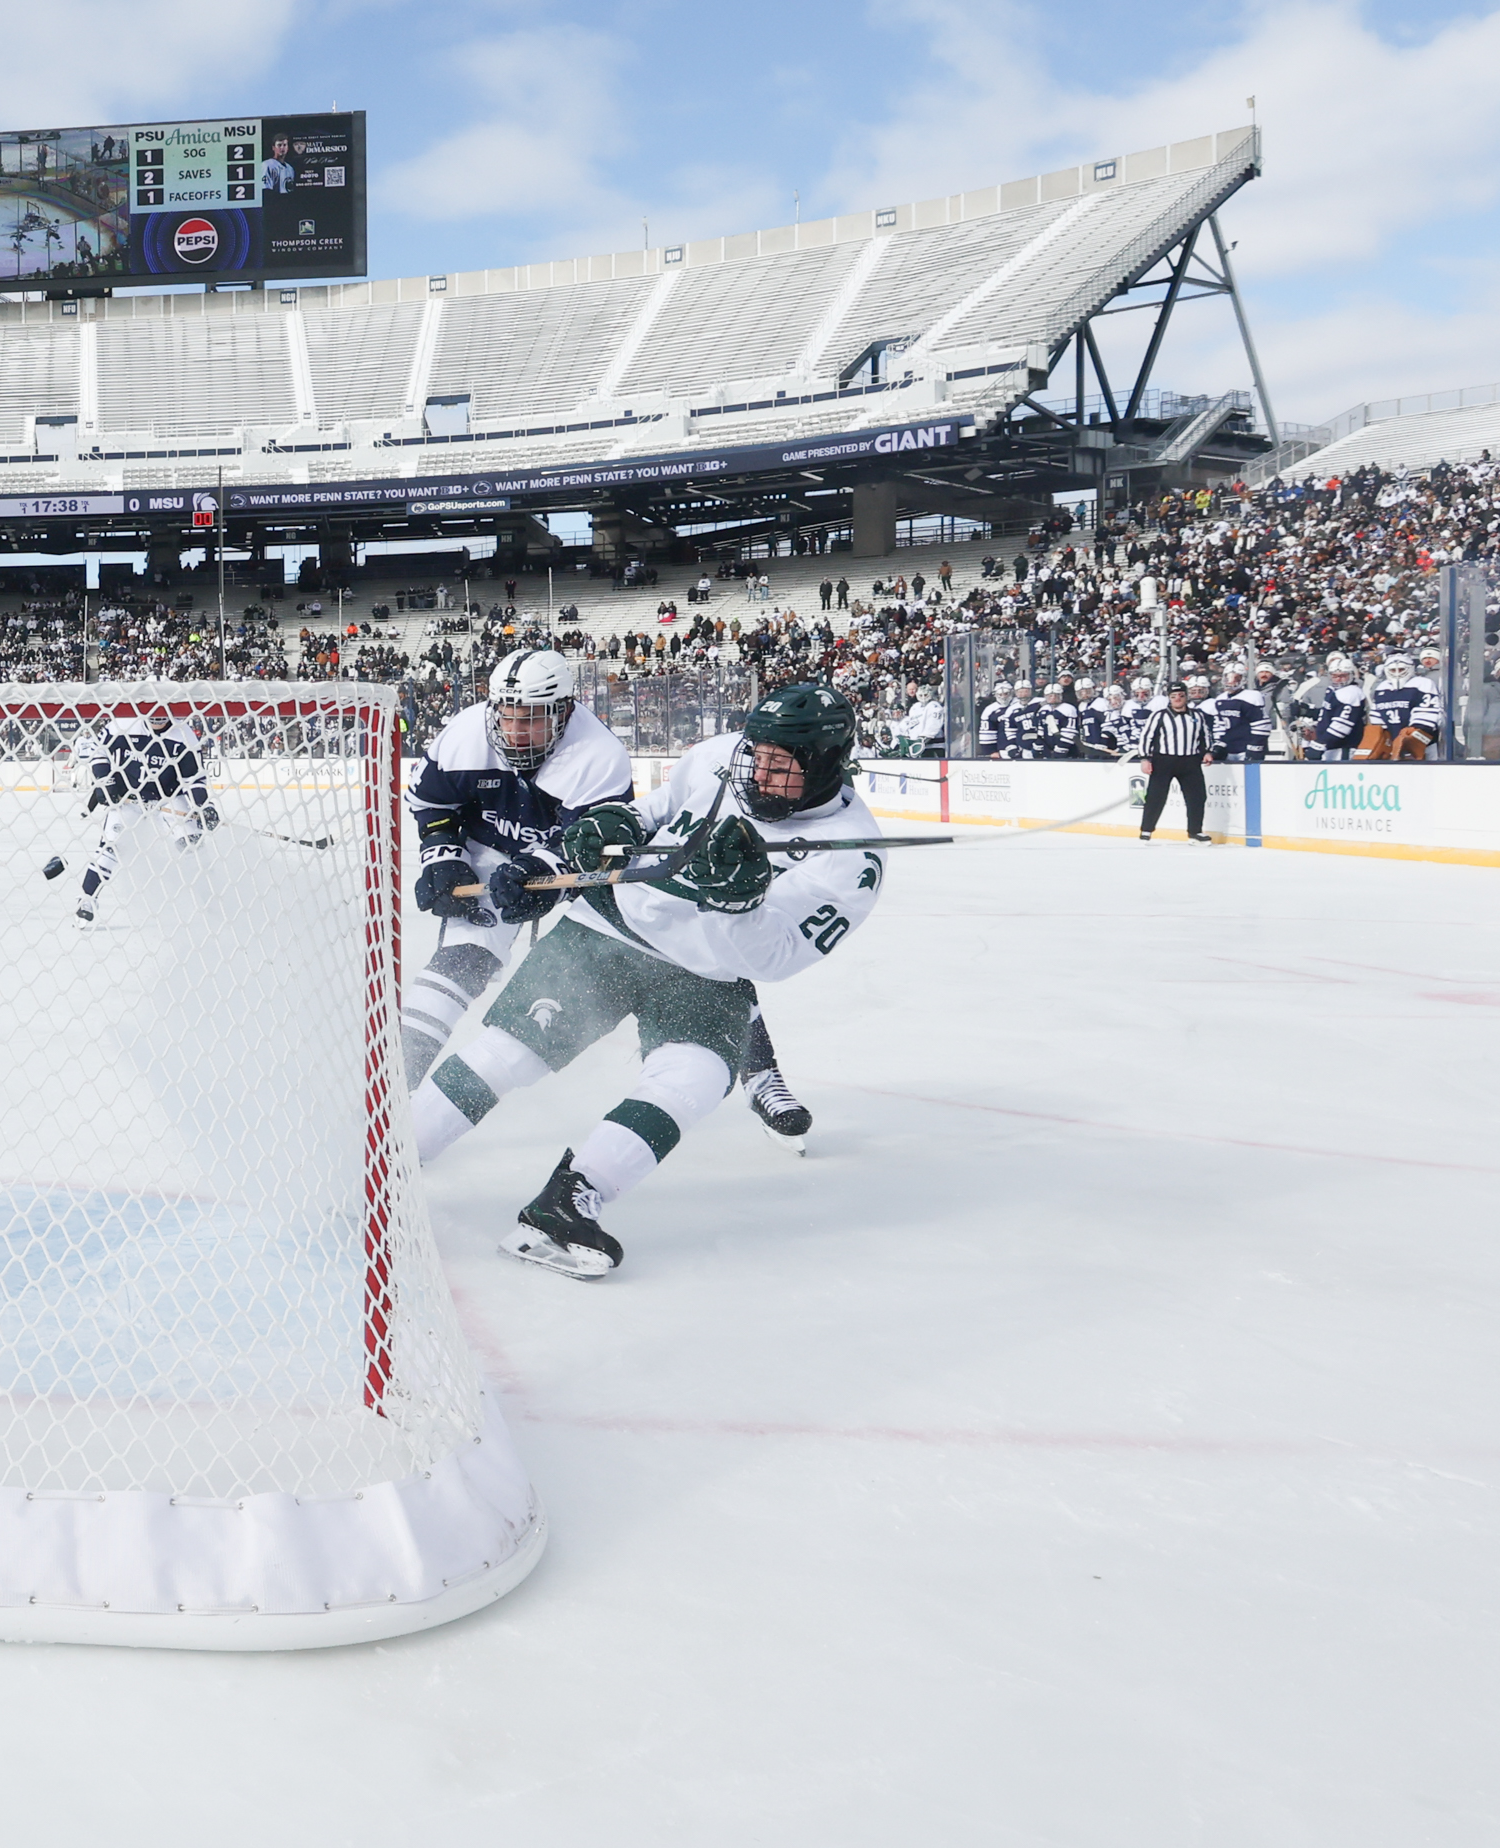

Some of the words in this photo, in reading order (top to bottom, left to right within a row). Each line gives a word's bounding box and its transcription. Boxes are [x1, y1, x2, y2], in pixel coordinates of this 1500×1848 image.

[135, 130, 165, 142] PSU
[165, 127, 222, 146] Amica
[224, 125, 256, 137] MSU
[144, 150, 152, 163] 1
[183, 148, 206, 158] SOG
[233, 146, 244, 159] 2
[144, 171, 154, 184] 2
[178, 169, 212, 180] SAVES
[236, 166, 244, 179] 1
[146, 191, 154, 204] 1
[169, 190, 221, 202] FACEOFFS
[235, 186, 246, 199] 2
[877, 213, 896, 225] NKU
[177, 235, 215, 246] PEPSI
[271, 239, 317, 247] THOMPSON
[319, 237, 343, 245] CREEK
[63, 304, 76, 313] NFU
[782, 450, 807, 462] GAME
[807, 445, 858, 459] PRESENTED
[858, 442, 872, 453] BY
[874, 425, 952, 454] GIANT
[495, 479, 528, 492] WANT
[529, 476, 561, 489] MORE
[562, 474, 592, 486] PENN
[594, 469, 634, 483] STATE?
[635, 466, 659, 479] YOU
[660, 462, 695, 476] WANT
[129, 498, 140, 511] 0
[149, 496, 184, 510] MSU
[250, 494, 283, 505] WANT
[284, 493, 313, 504] MORE
[313, 492, 343, 503] PENN
[343, 490, 382, 501] STATE?
[384, 488, 406, 499] YOU
[407, 486, 439, 497] WANT
[31, 500, 79, 513] 17:38
[427, 499, 506, 511] GoPSUsports.com
[760, 700, 783, 713] 20
[1208, 784, 1238, 797] CREEK
[1304, 768, 1402, 812] Amica
[1207, 801, 1238, 809] MPANY
[1315, 816, 1393, 833] INSURANCE
[798, 904, 850, 955] 20
